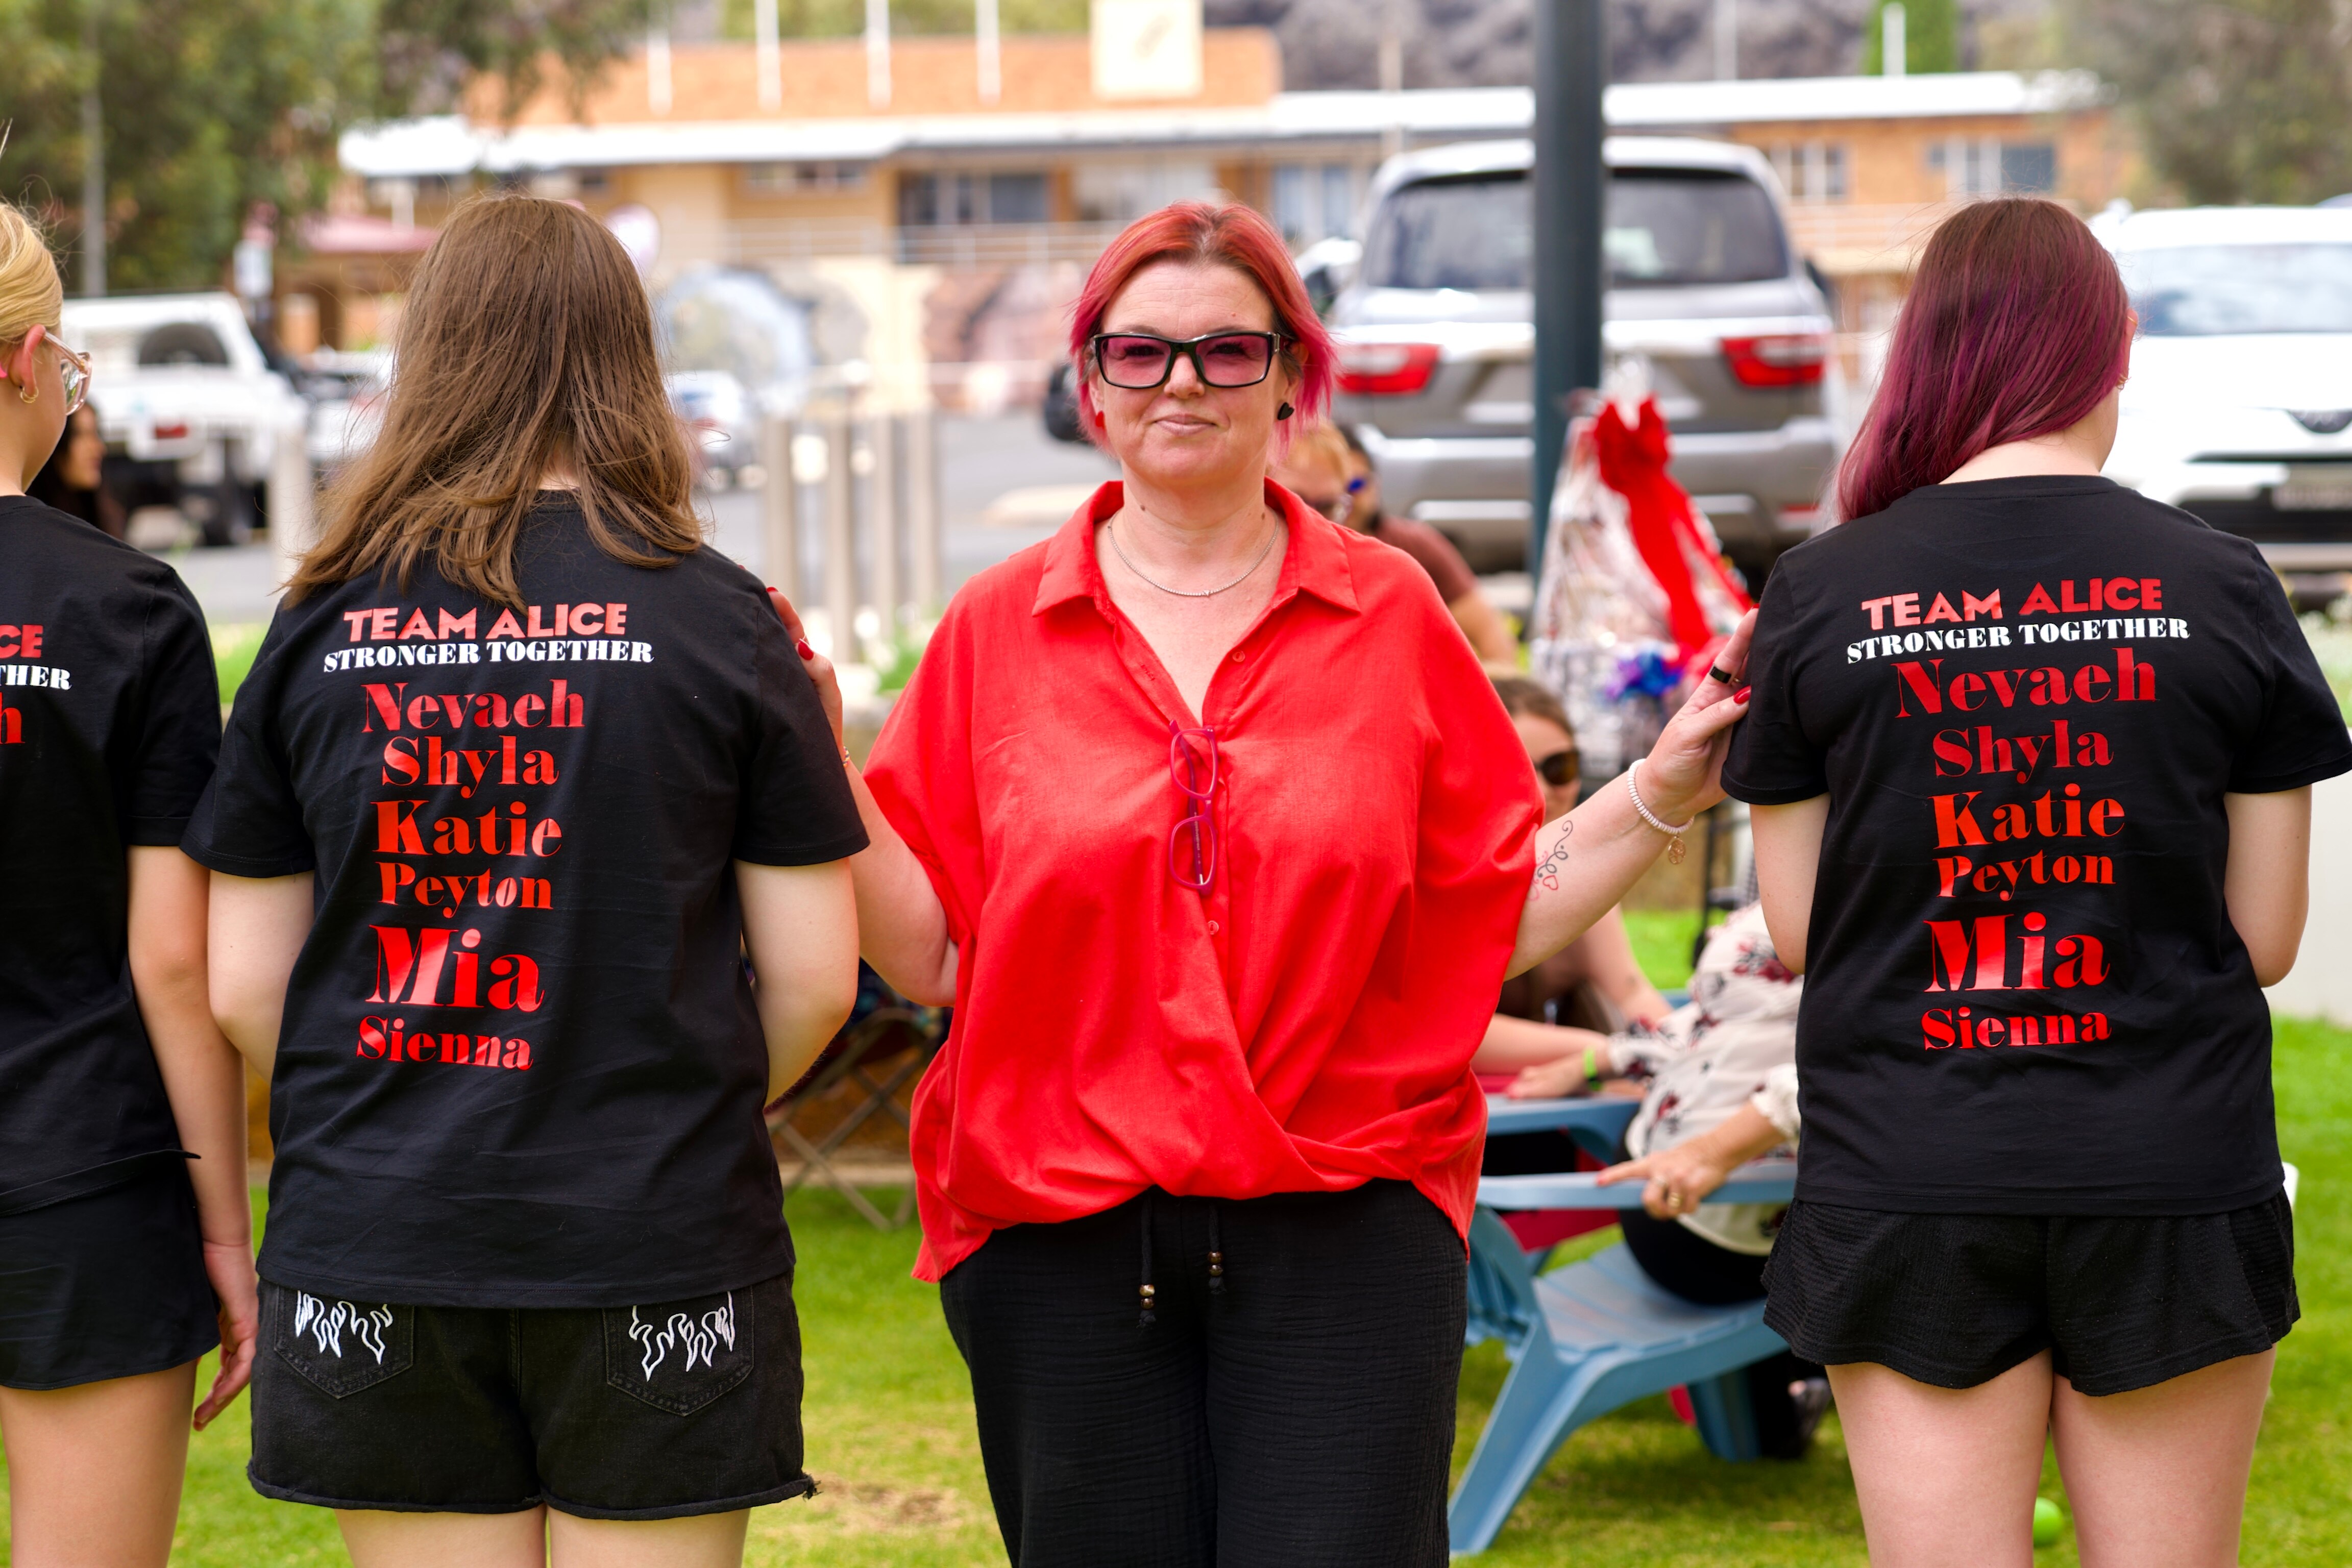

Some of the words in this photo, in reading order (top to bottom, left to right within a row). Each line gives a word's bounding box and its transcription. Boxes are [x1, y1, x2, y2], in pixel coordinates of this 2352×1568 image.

[342, 606, 477, 643] TEAM
[485, 602, 628, 640] ALICE
[1860, 588, 2003, 631] TEAM
[2018, 577, 2163, 616] ALICE
[323, 643, 481, 673] STRONGER
[486, 640, 655, 664] TOGETHER
[1847, 626, 2013, 665] STRONGER
[2018, 617, 2191, 645] TOGETHER
[360, 678, 585, 733] Nevaeh
[1890, 647, 2157, 719] Nevaeh
[381, 735, 559, 799] Shyla
[1932, 719, 2114, 784] Shyla
[370, 800, 562, 857] Katie
[1927, 783, 2125, 849] Katie
[375, 862, 554, 919] Peyton
[1933, 849, 2117, 901] Peyton
[364, 924, 545, 1013] Mia
[1923, 911, 2111, 992] Mia
[356, 1015, 534, 1071] Sienna
[1921, 1006, 2112, 1051] Sienna
